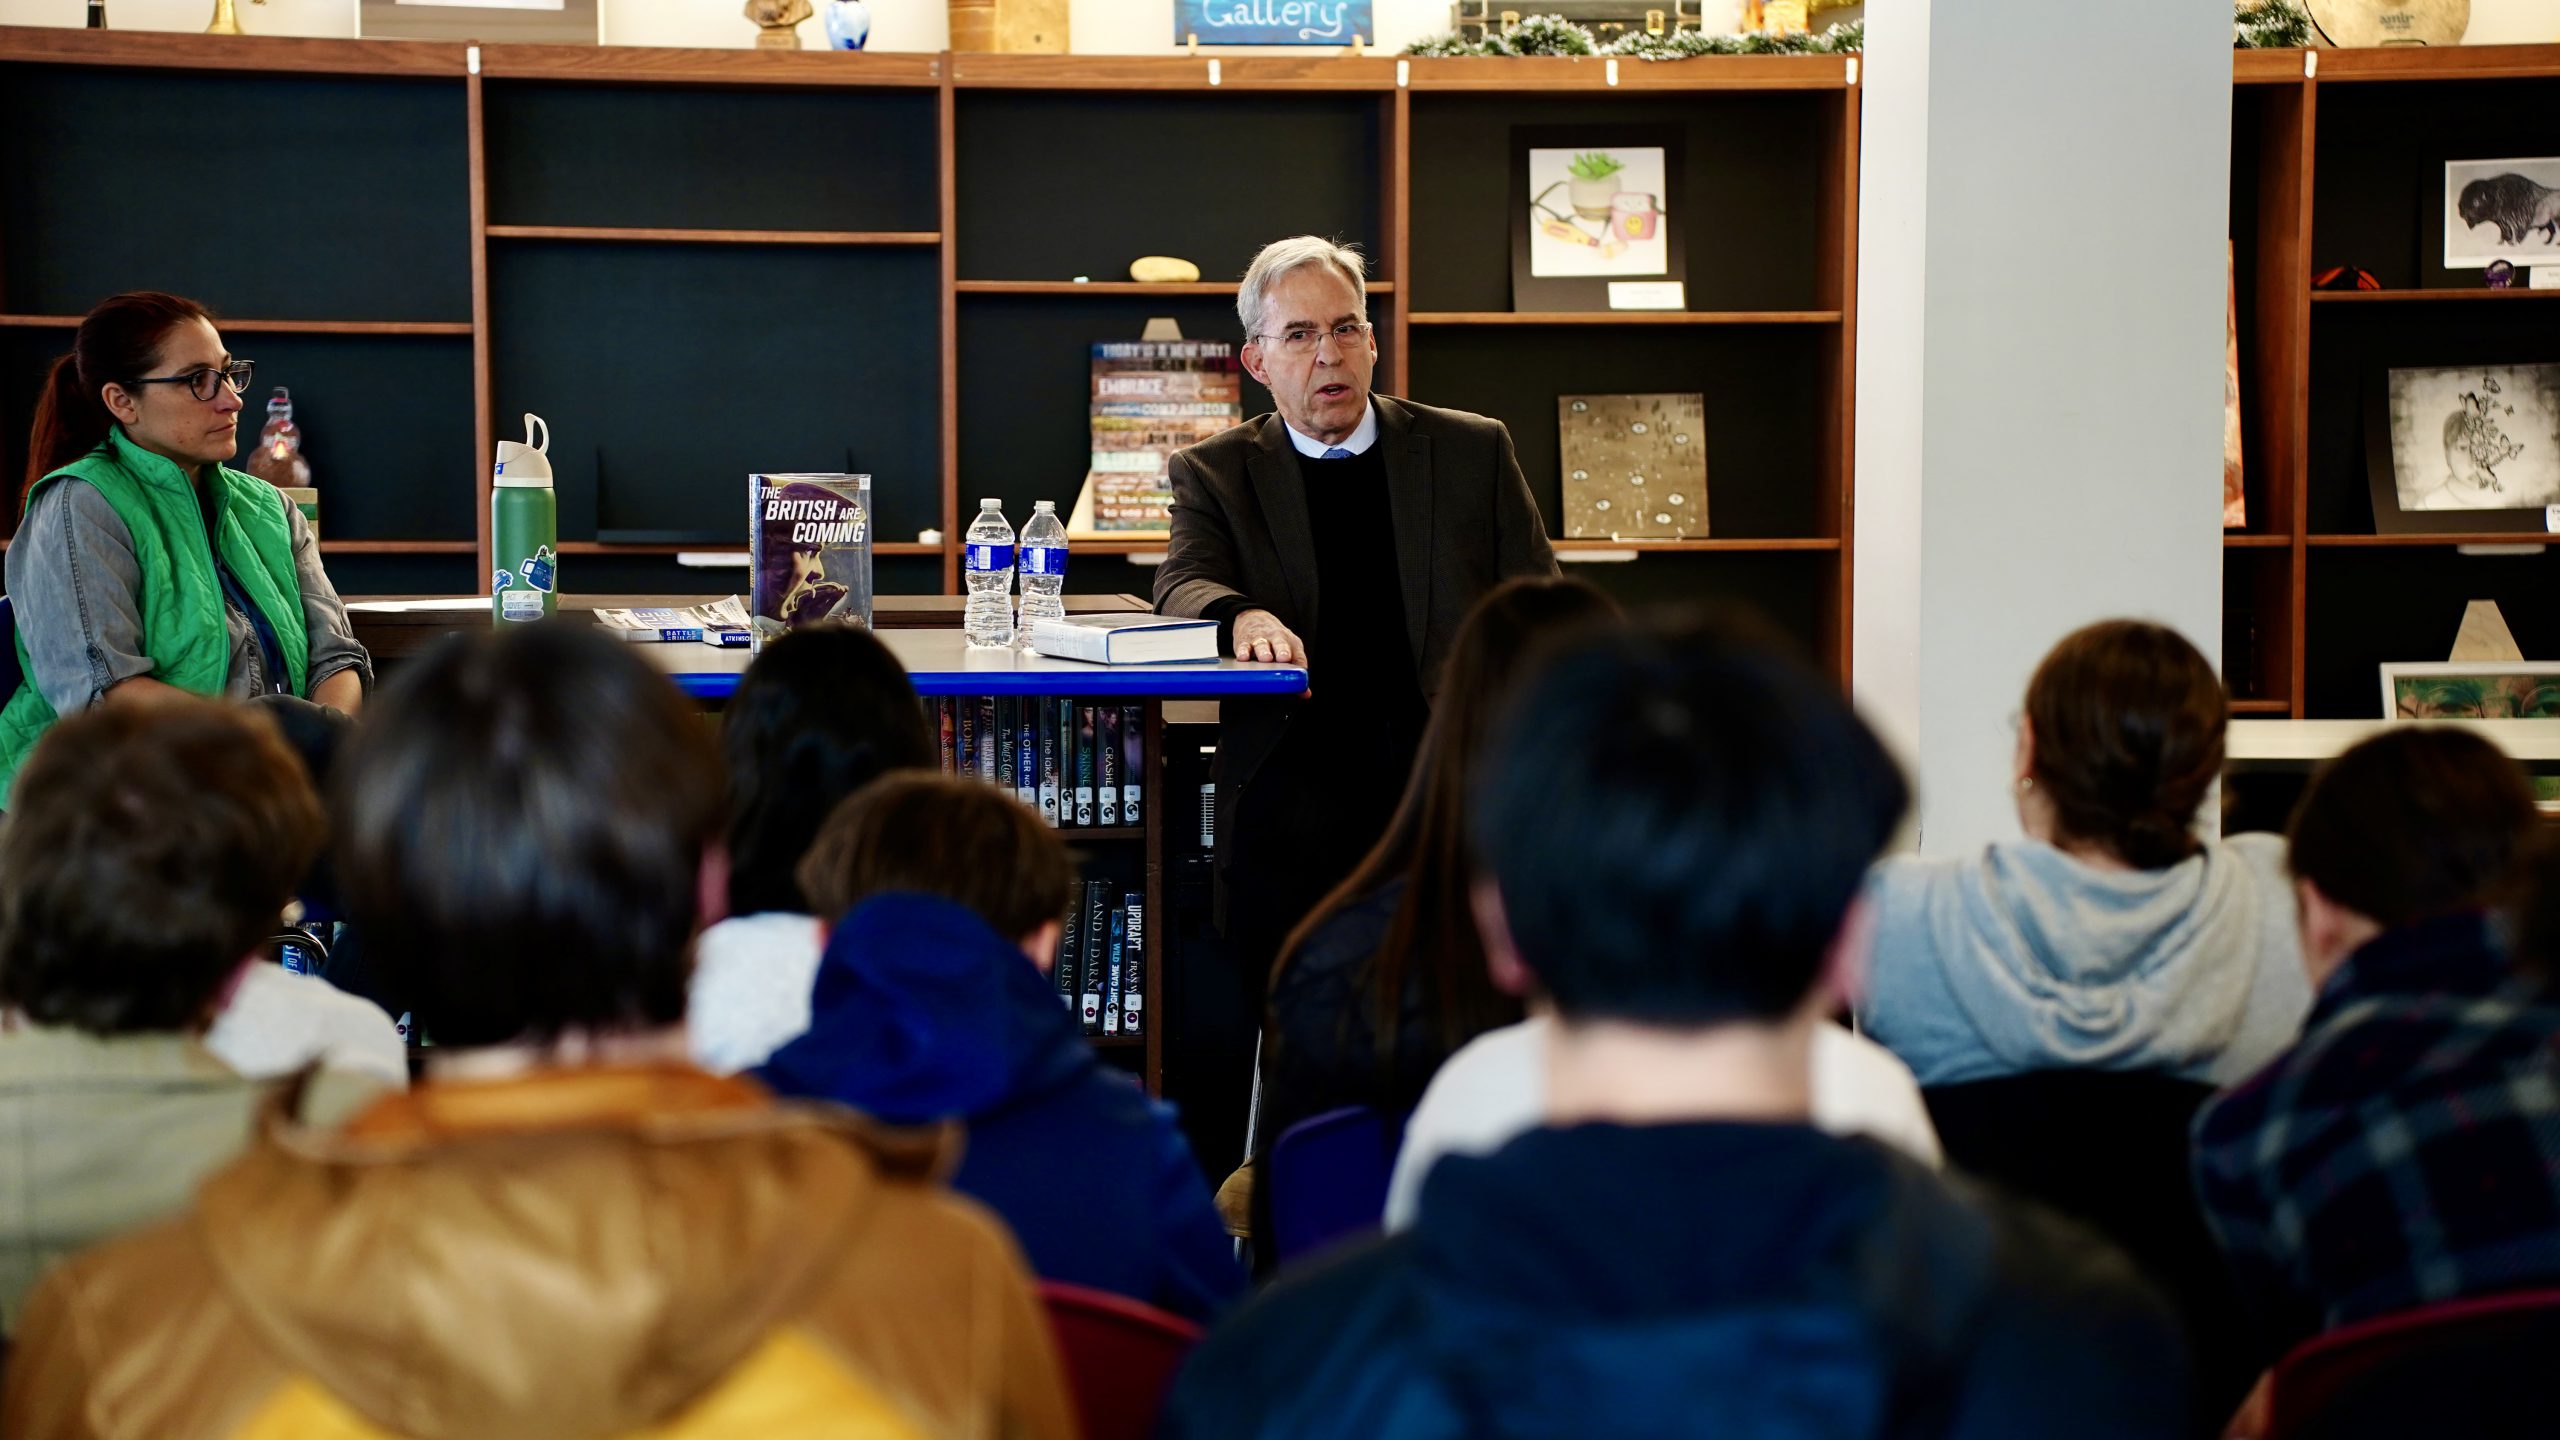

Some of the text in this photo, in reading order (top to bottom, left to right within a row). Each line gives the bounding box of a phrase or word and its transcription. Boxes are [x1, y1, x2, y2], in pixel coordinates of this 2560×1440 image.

[1203, 0, 1348, 40] Gallery
[760, 486, 781, 500] THE
[765, 500, 861, 521] BRITISH ARE
[792, 522, 866, 544] COMING
[1022, 739, 1031, 772] OTHER
[1044, 739, 1053, 755] the
[1081, 747, 1091, 786] SKINNE
[1105, 746, 1114, 786] CRASHE
[1064, 912, 1077, 947] NOW
[1092, 900, 1103, 931] AND
[1127, 904, 1142, 951] UPDRAFT
[1112, 943, 1121, 962] WILD
[1087, 948, 1101, 994] DARKE
[1110, 964, 1120, 1003] GHT GAME
[1129, 960, 1138, 983] FRAN
